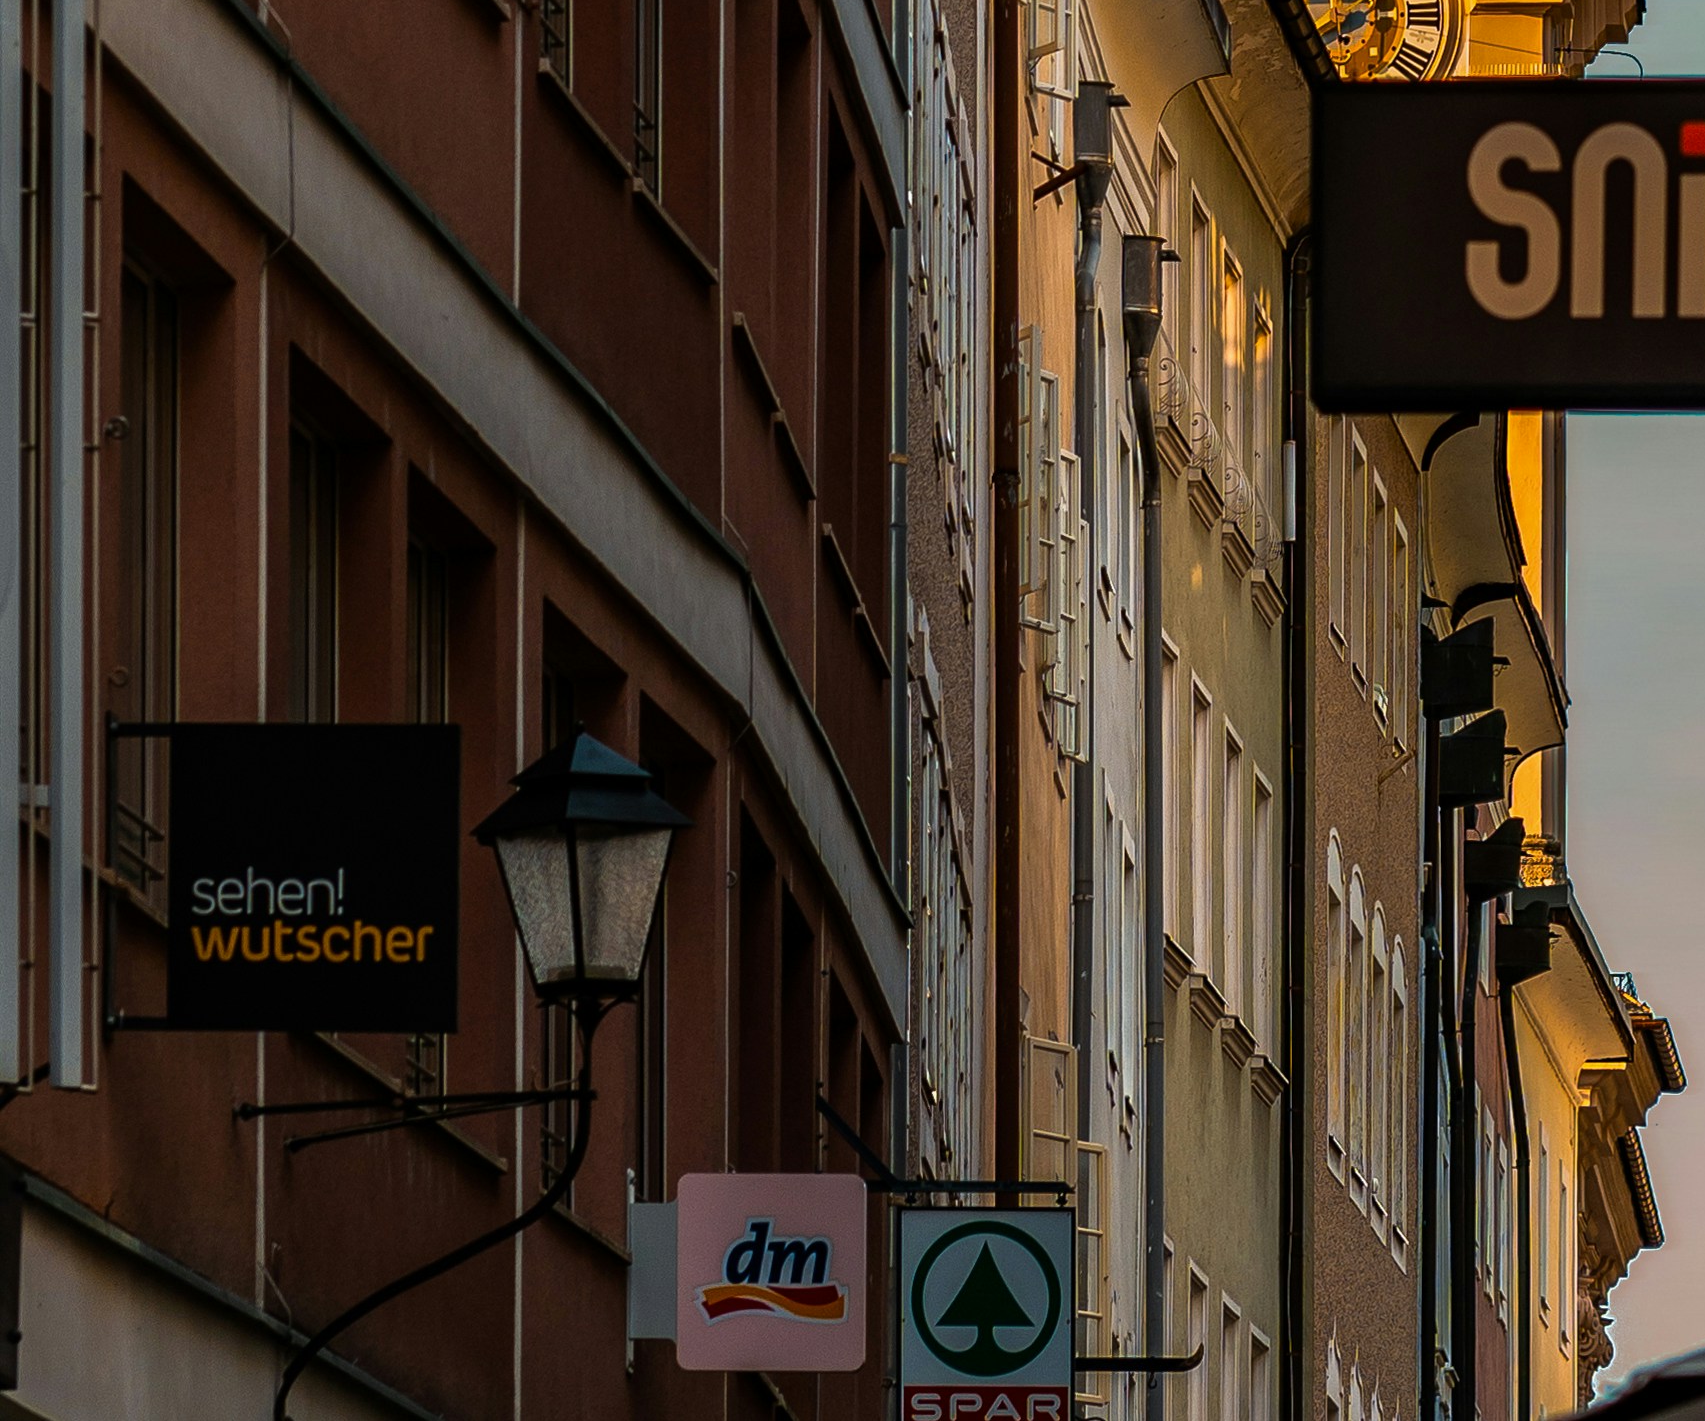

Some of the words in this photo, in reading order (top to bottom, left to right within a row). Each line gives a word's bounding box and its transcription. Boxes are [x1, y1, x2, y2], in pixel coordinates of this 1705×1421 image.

[191, 866, 344, 915] sehen!
[191, 919, 434, 963] wutscher
[723, 1221, 829, 1284] dm
[910, 1392, 1061, 1421] SPAR
